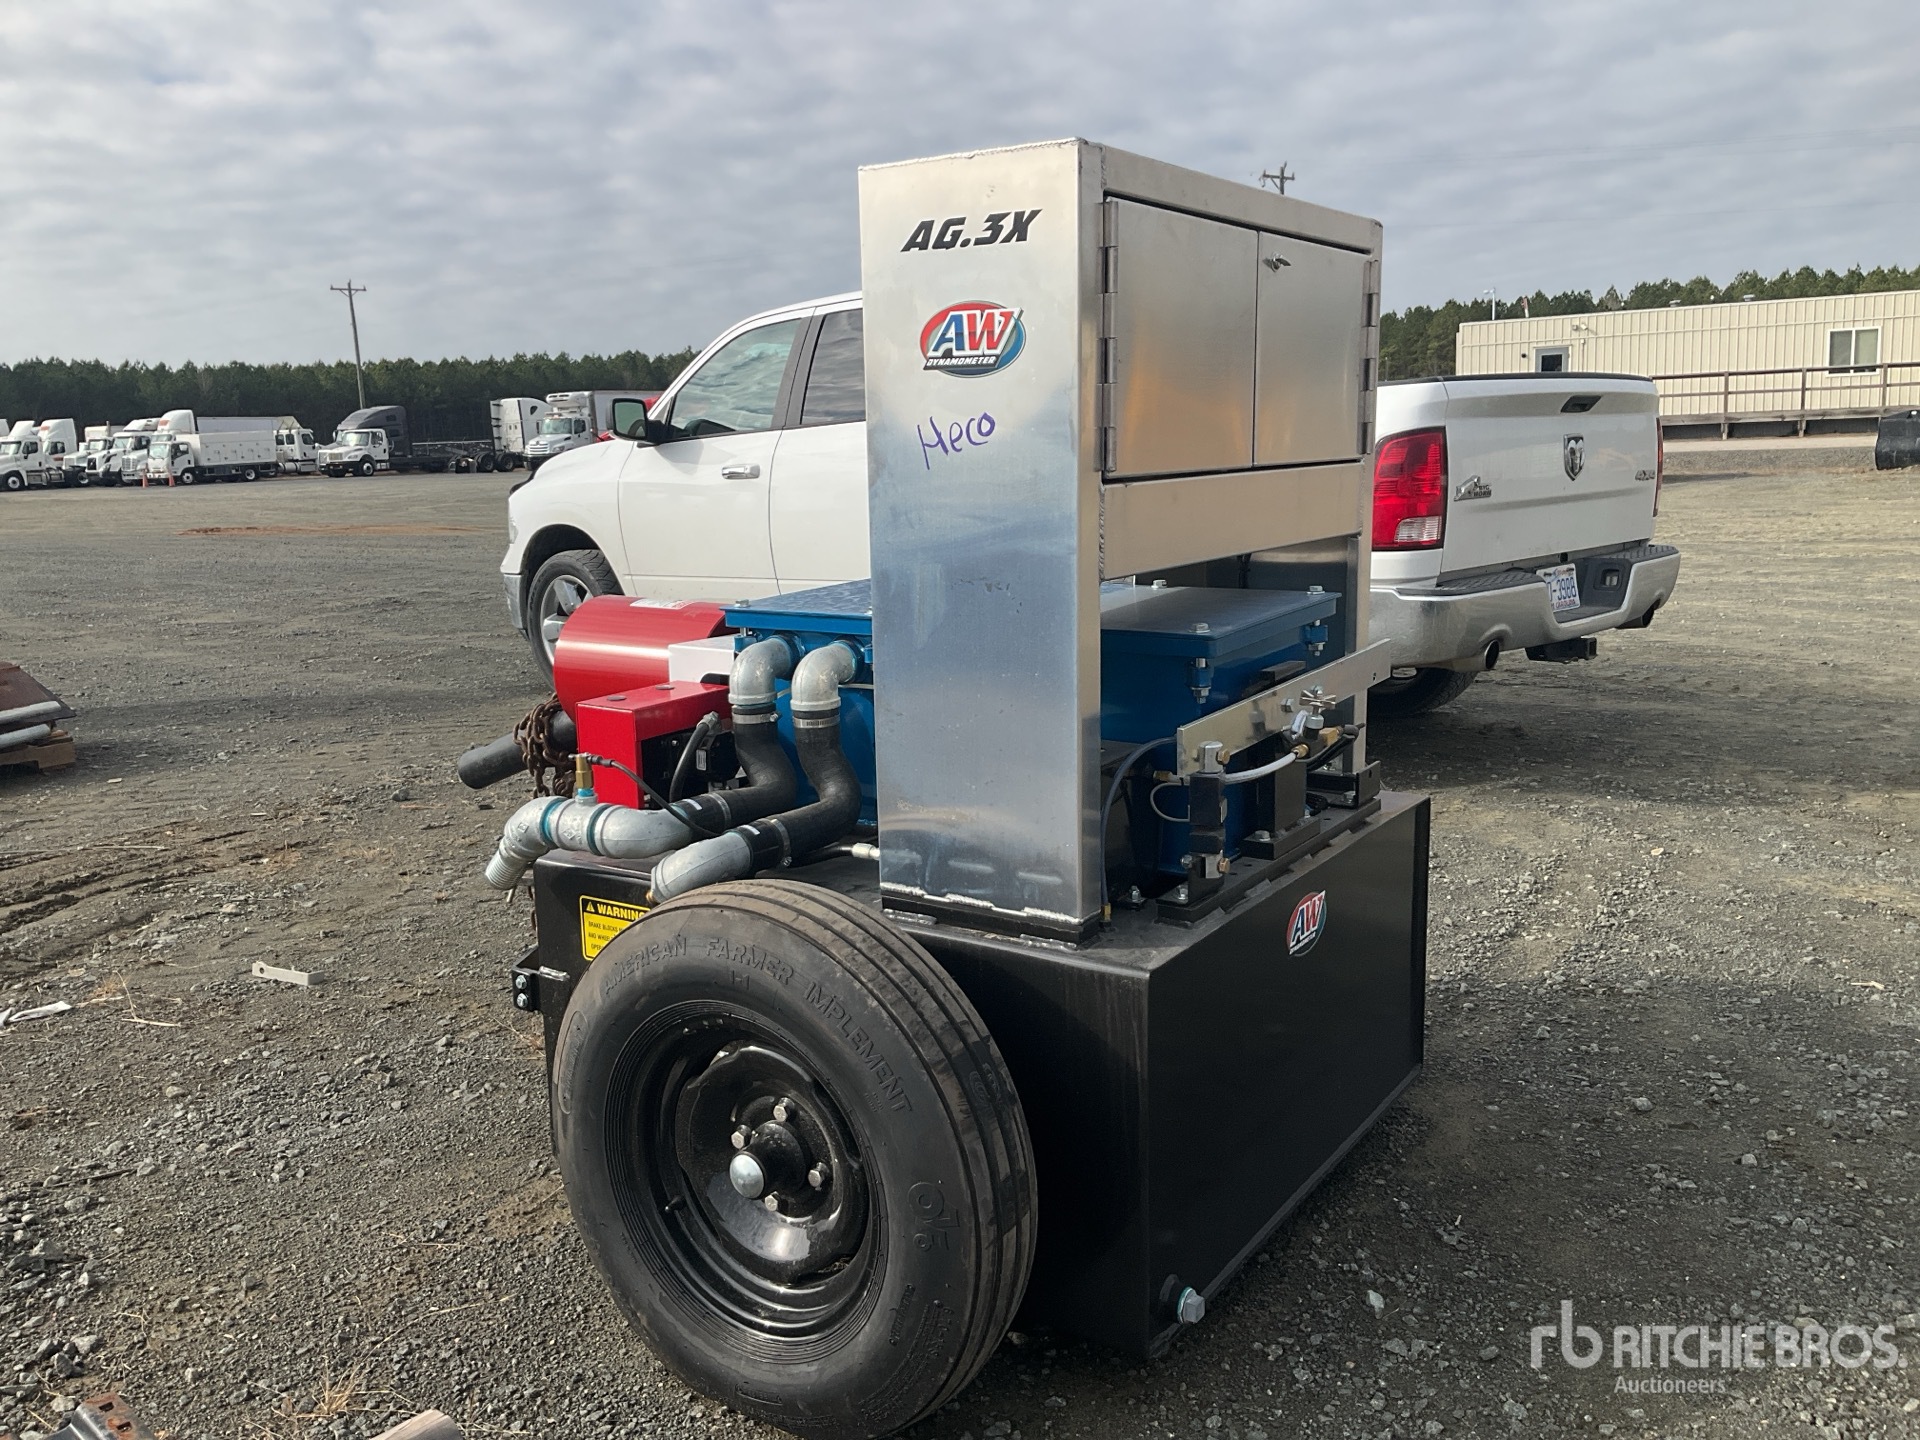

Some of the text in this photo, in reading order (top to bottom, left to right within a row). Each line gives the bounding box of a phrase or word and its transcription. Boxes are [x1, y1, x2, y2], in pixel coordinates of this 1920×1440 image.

[900, 208, 1042, 252] AG.3X
[928, 307, 1022, 356] AW
[926, 355, 996, 367] DYNAMOMETER
[588, 920, 602, 930] BRAKE
[602, 924, 618, 933] BLOCKS
[588, 931, 597, 939] AND
[1289, 889, 1326, 949] AW
[605, 935, 913, 1112] AMERICAN FARMER IMPLEMENT
